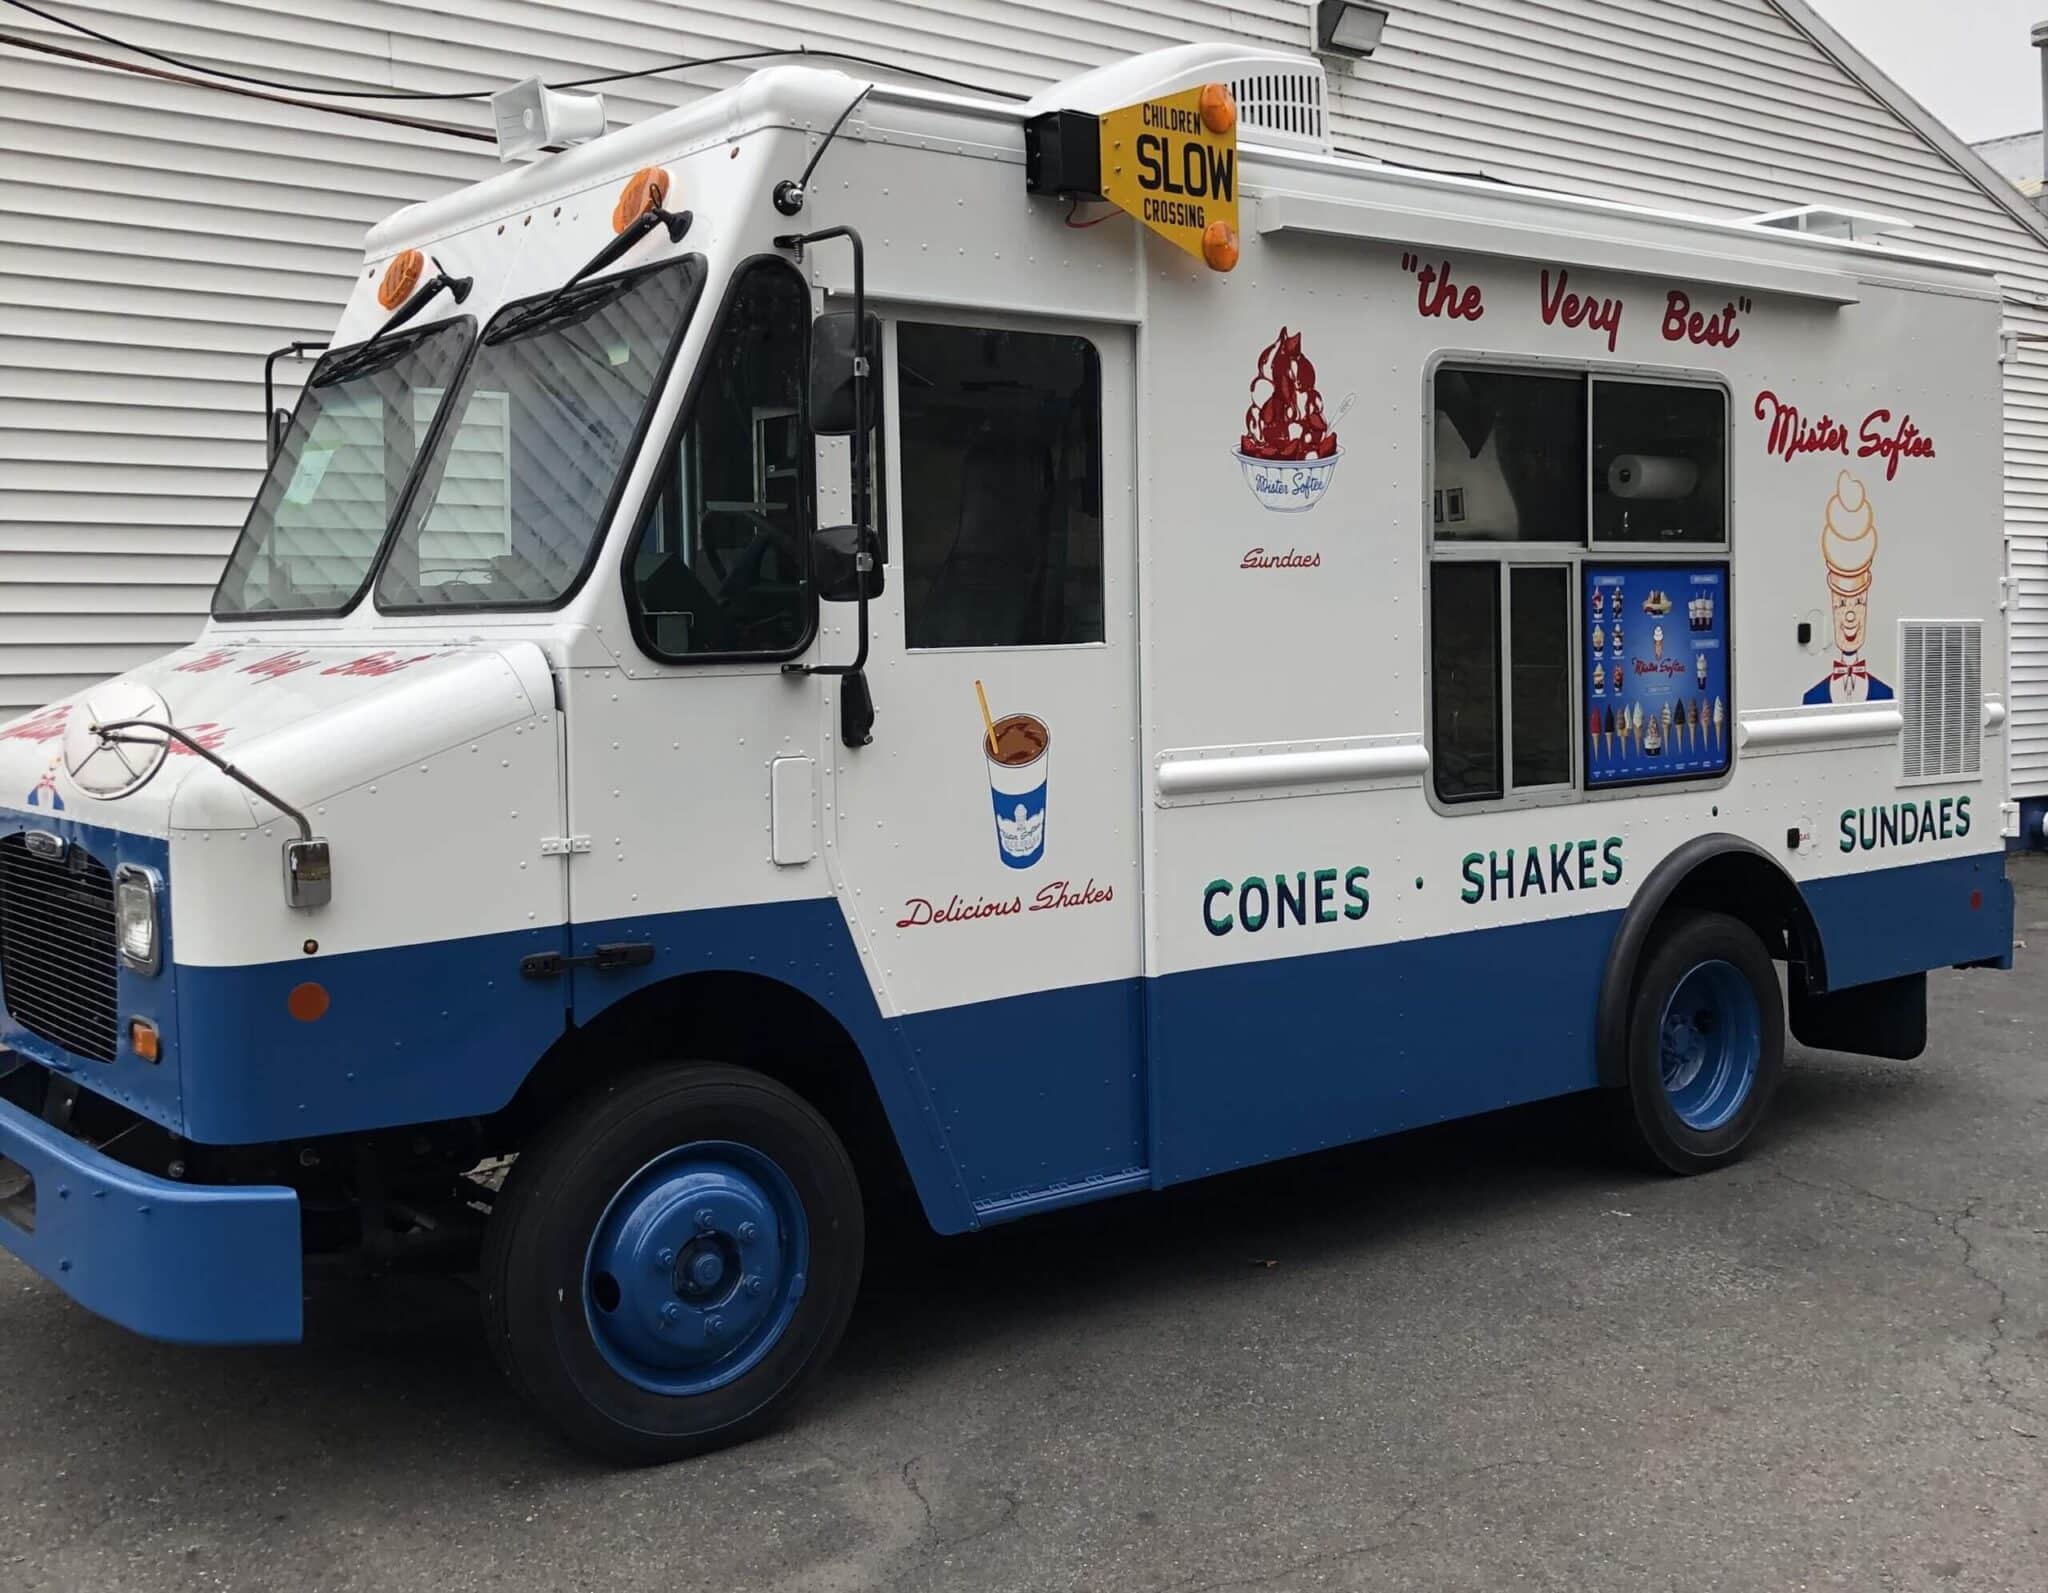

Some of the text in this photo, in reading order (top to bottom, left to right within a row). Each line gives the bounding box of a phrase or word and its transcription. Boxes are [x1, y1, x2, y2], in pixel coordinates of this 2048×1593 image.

[1142, 103, 1201, 136] CHILDREN
[1136, 133, 1234, 202] SLOW
[1143, 198, 1205, 228] CROSSING
[1540, 269, 1623, 352] Very
[1754, 390, 1936, 481] Mister Softee
[1240, 548, 1321, 569] Sundaes
[1202, 795, 1972, 937] CONES SHAKES SUNDAES
[896, 878, 1114, 928] Delicious Shakes
